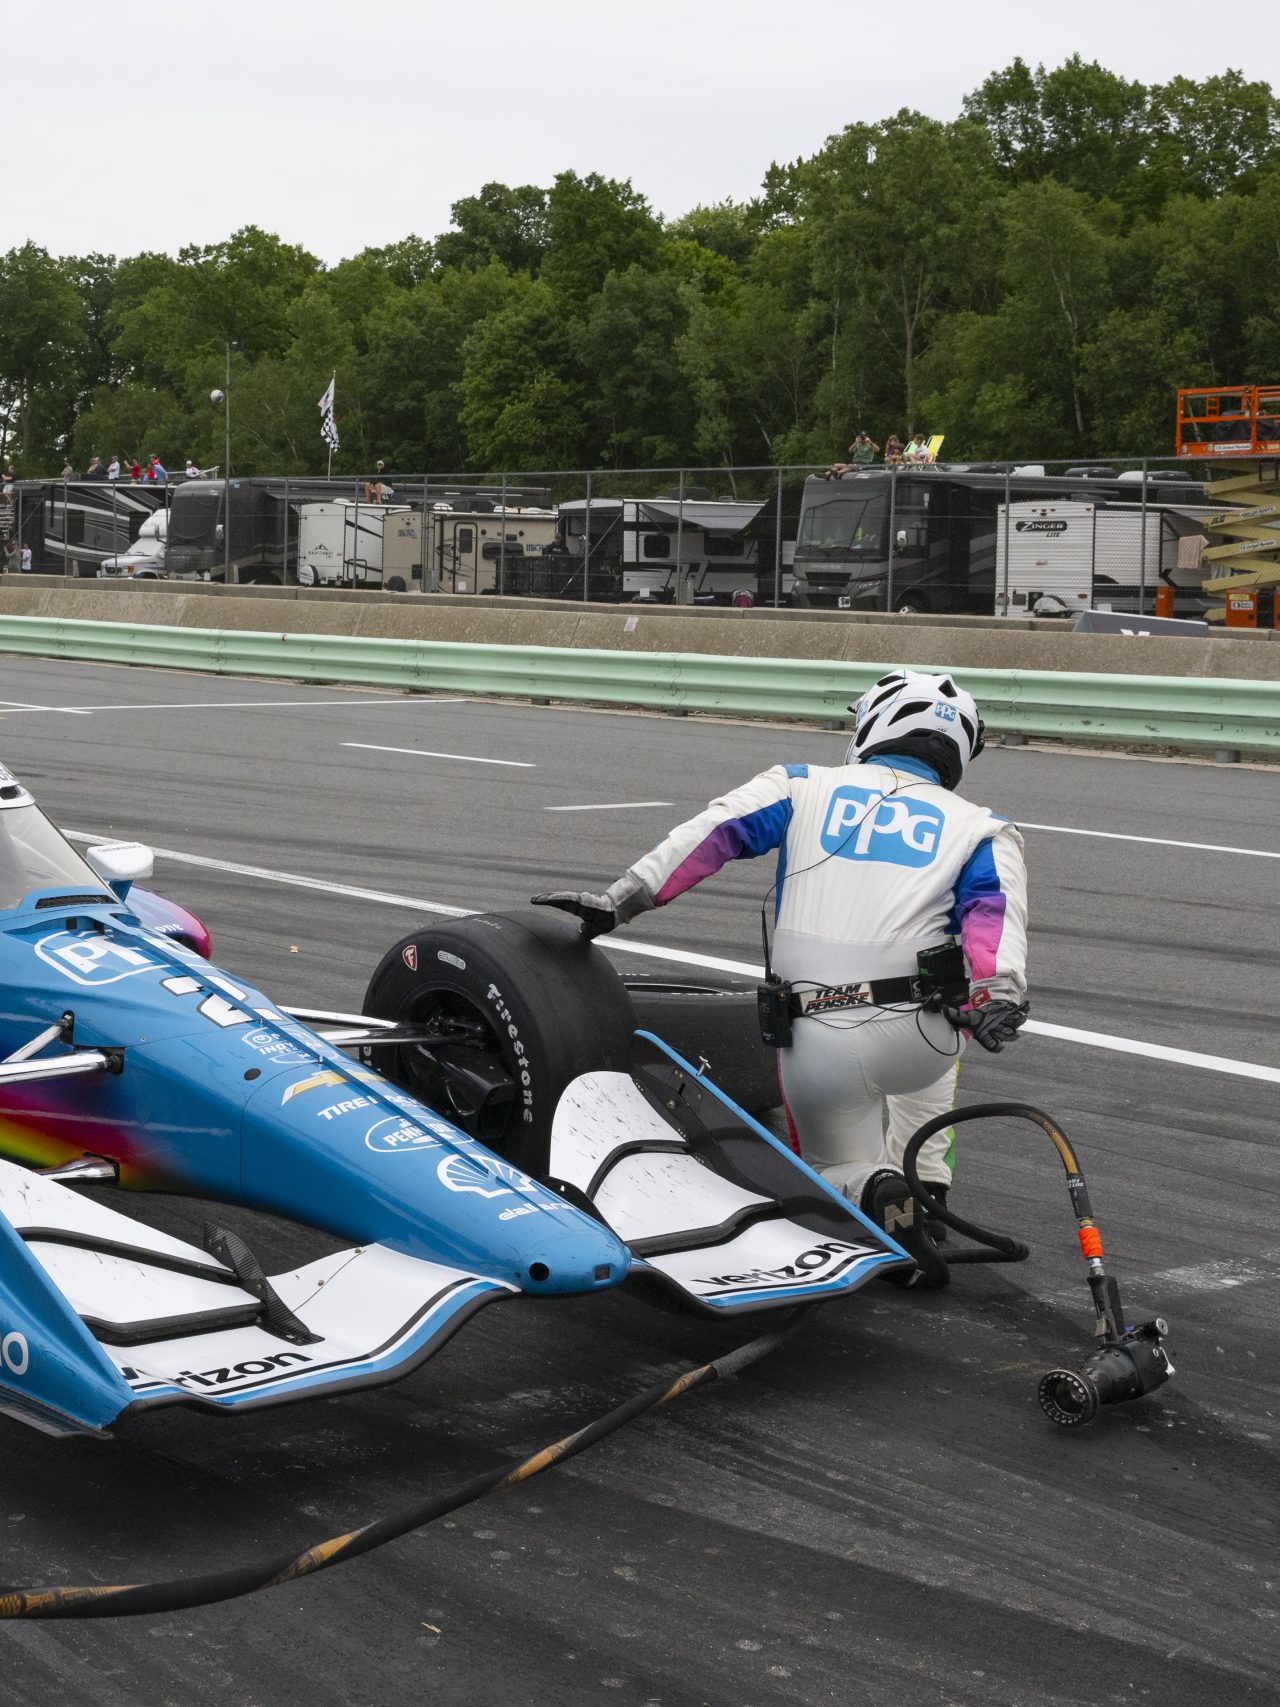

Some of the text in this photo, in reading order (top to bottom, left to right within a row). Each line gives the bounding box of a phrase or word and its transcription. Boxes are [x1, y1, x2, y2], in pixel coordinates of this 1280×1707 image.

[1020, 521, 1065, 532] ZINGER
[936, 702, 956, 720] PPG
[825, 793, 940, 855] PPG
[804, 995, 869, 1013] PENSKE
[815, 983, 863, 999] TEAM
[486, 983, 534, 1124] Firestone
[690, 1241, 862, 1287] verizon
[122, 1352, 314, 1388] rizon
